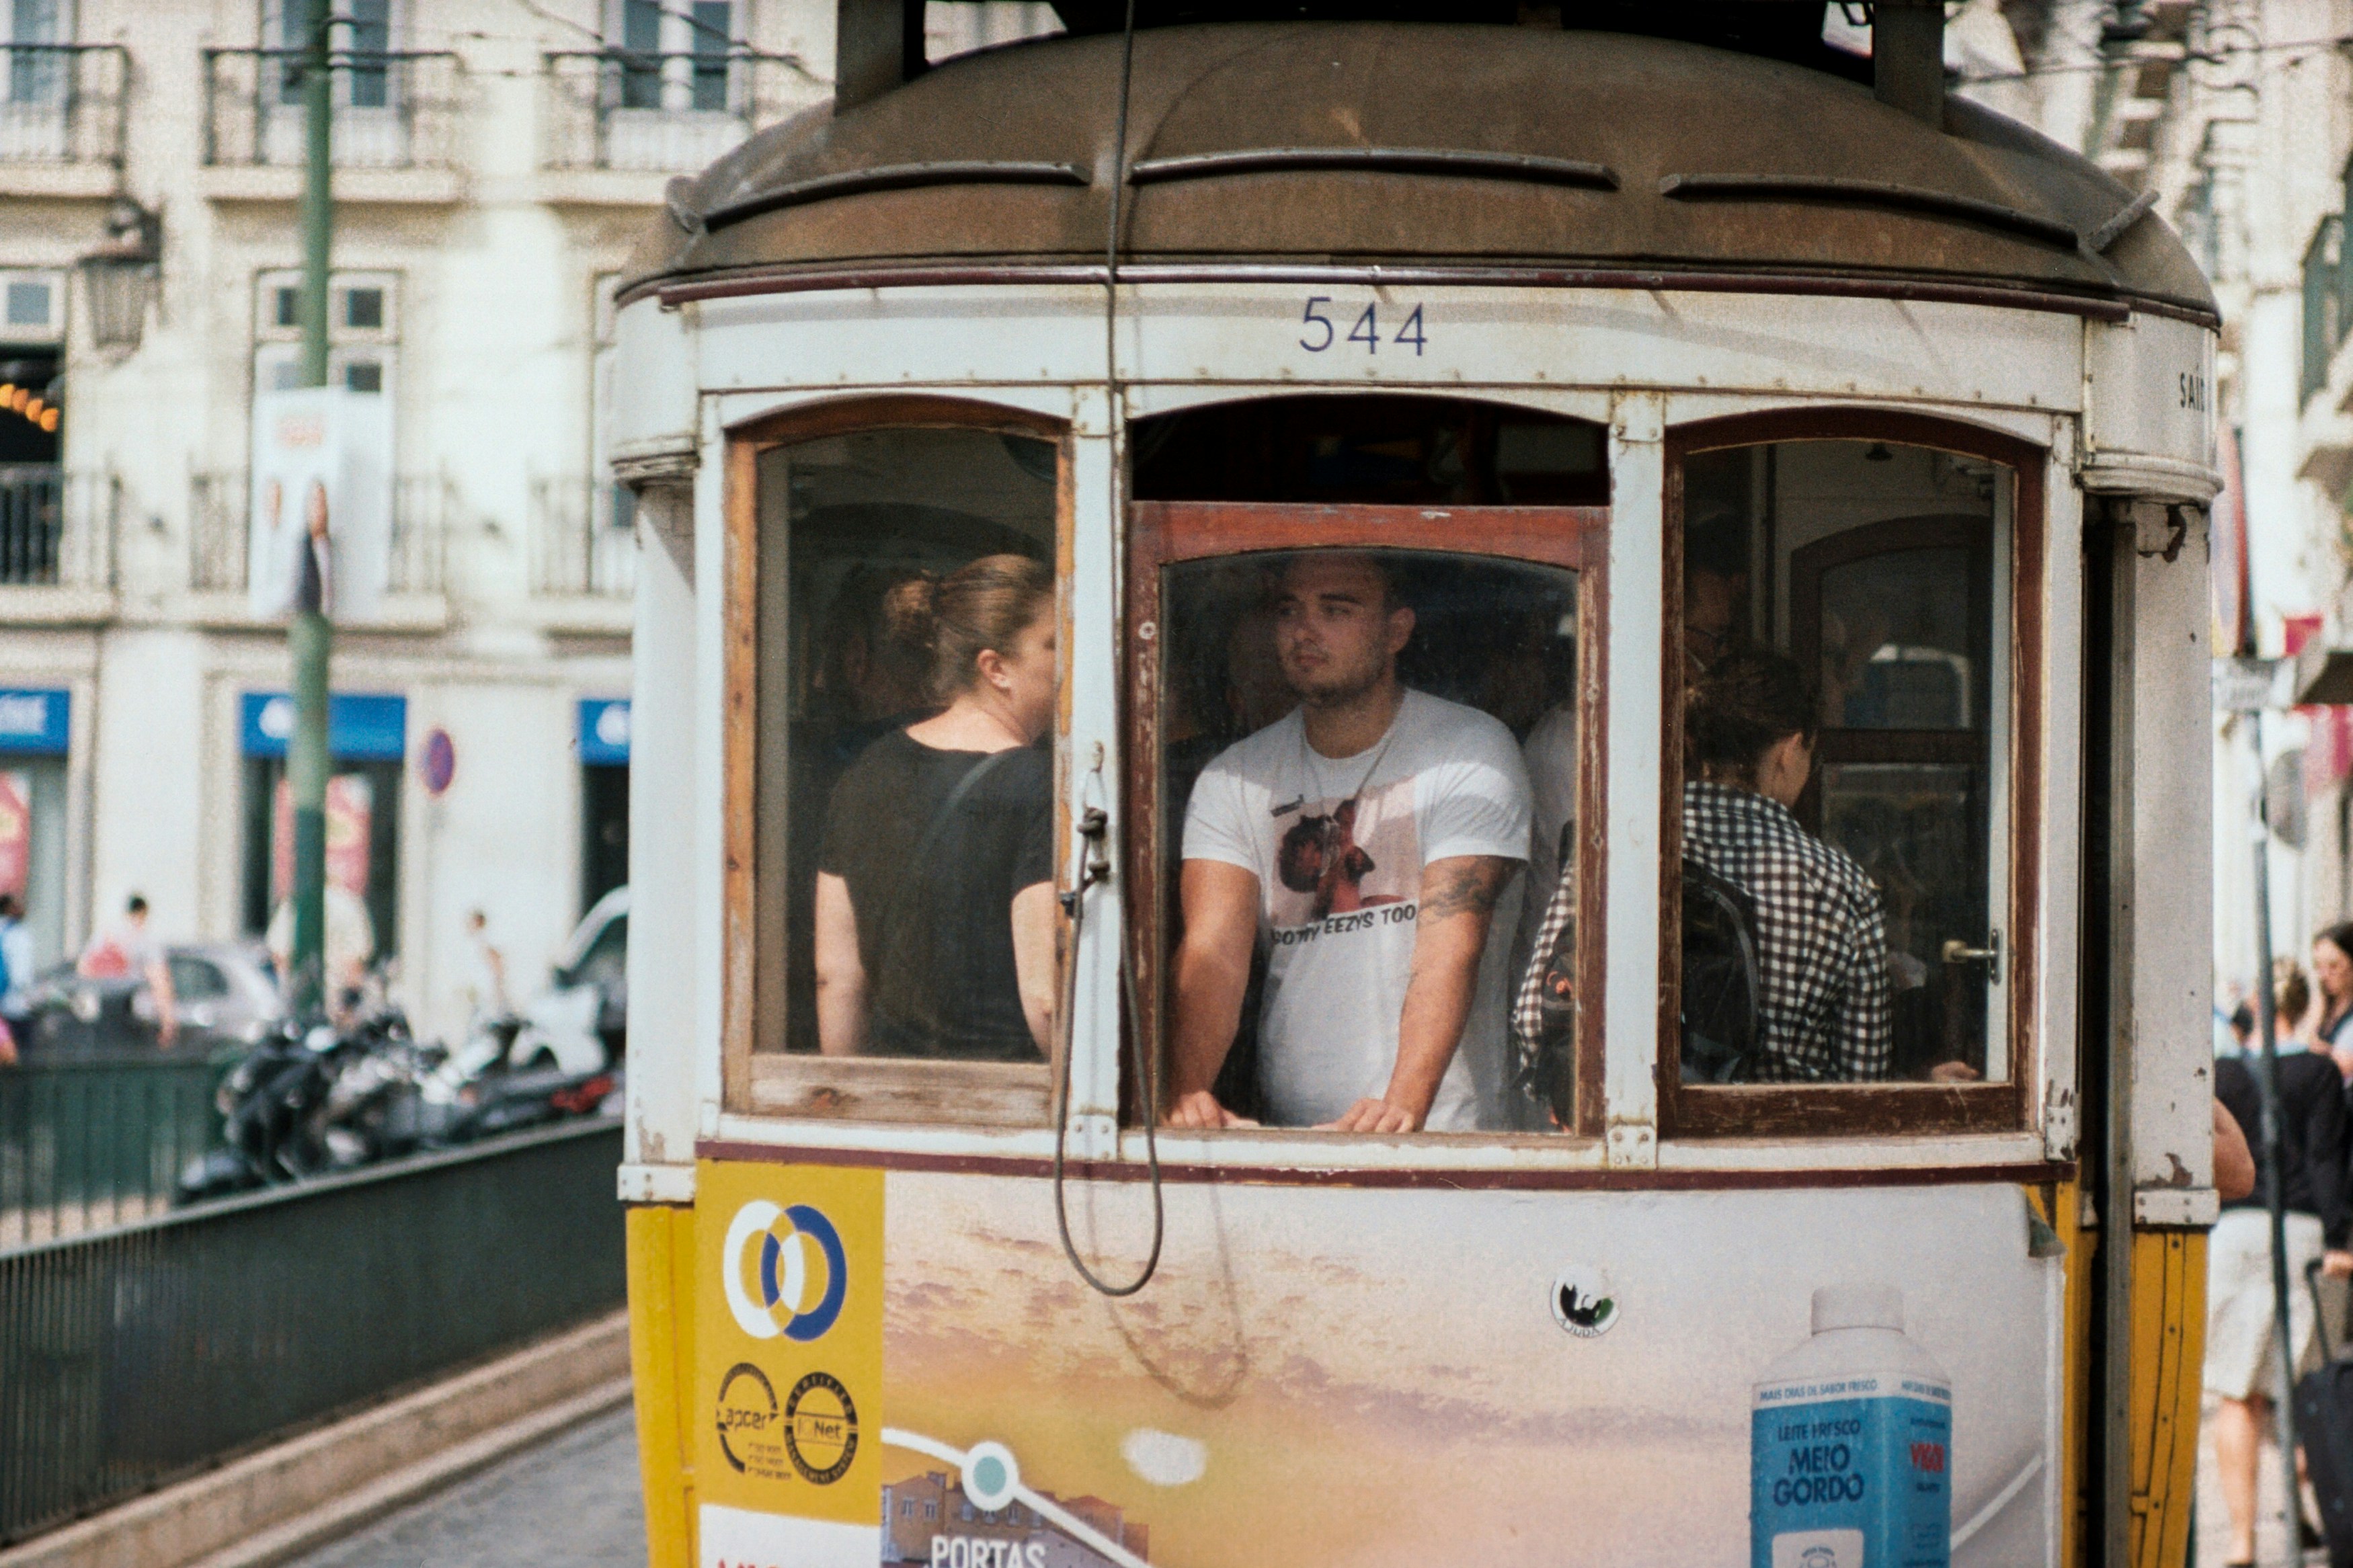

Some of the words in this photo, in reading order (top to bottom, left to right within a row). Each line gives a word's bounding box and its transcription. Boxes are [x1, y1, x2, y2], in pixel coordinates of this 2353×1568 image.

[1300, 296, 1428, 356] 544
[1381, 904, 1417, 925] TOO
[1759, 1389, 1782, 1402] MAIS
[1784, 1386, 1805, 1399] DIAS
[1819, 1382, 1846, 1395] SABOR
[1848, 1379, 1878, 1393] FRESCO
[1778, 1423, 1808, 1442] LEITE
[1812, 1419, 1862, 1438] FRESCO
[1788, 1443, 1851, 1475] MEIO
[1773, 1473, 1865, 1508] GORDO
[931, 1534, 1045, 1568] PORTAS
